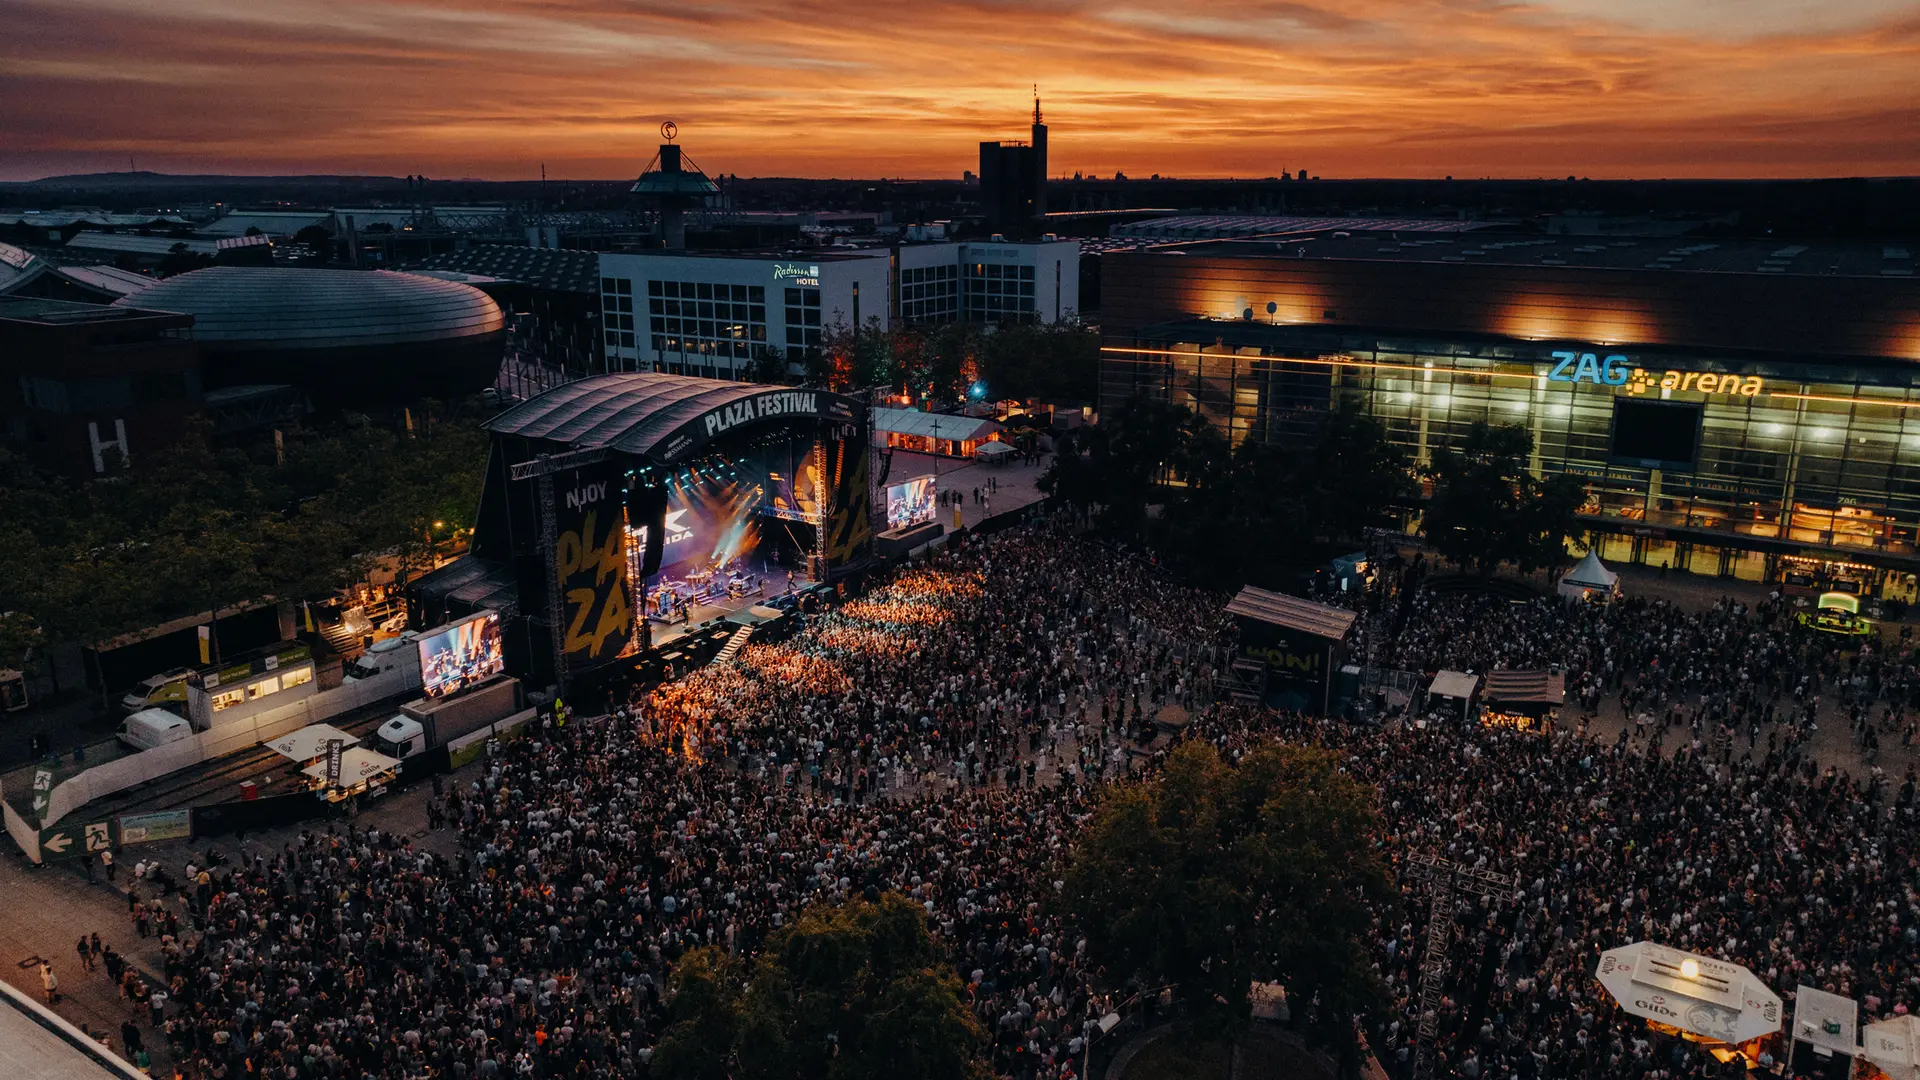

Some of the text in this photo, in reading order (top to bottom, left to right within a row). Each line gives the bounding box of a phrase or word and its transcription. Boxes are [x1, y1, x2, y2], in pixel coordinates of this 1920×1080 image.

[774, 263, 810, 280] Radisson
[796, 278, 819, 286] HOTEL
[1549, 351, 1763, 397] ZAG arena
[704, 392, 818, 437] PLAZA FESTIVAL
[1836, 497, 1857, 506] ZAG
[564, 579, 630, 659] ZA
[331, 742, 341, 777] DRINKS
[1635, 1000, 1678, 1019] Gilde
